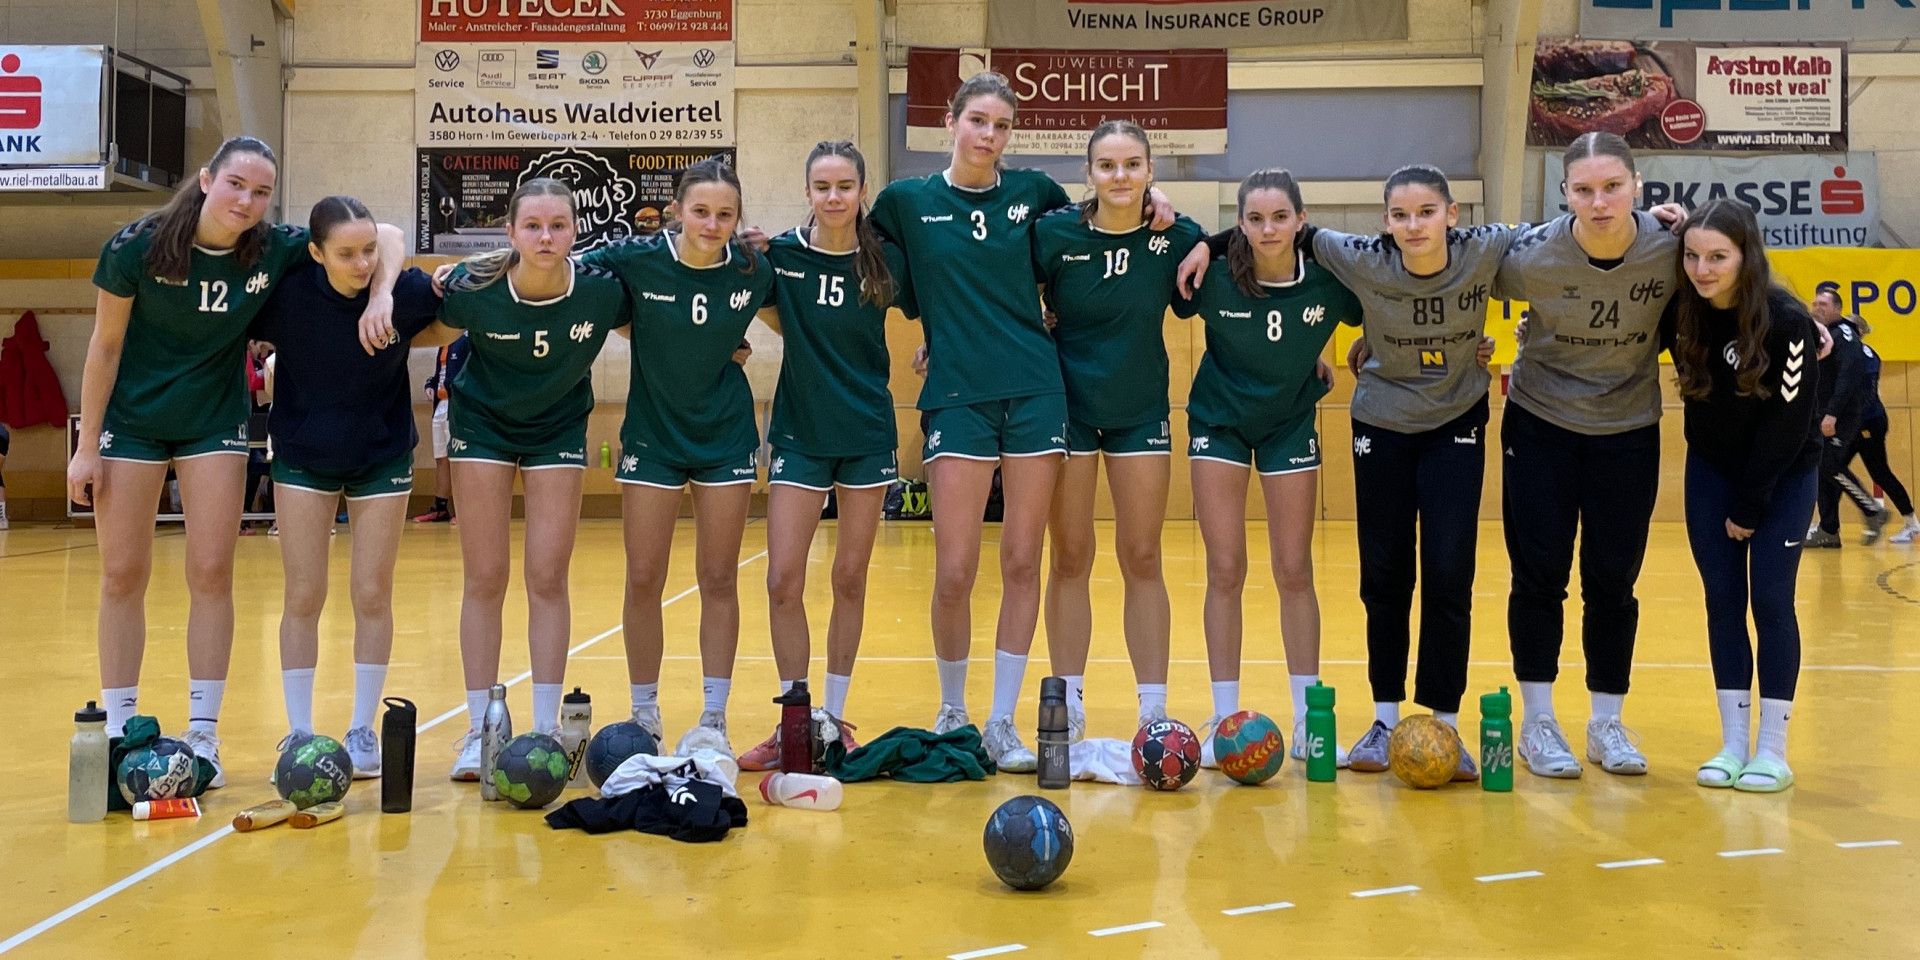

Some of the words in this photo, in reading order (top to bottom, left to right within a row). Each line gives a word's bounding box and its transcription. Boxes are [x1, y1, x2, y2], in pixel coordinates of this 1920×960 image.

[644, 9, 668, 19] 3730
[670, 8, 722, 21] Eggenburg
[1067, 9, 1138, 30] VIENNA
[1144, 10, 1251, 30] INSURANCE
[1257, 7, 1325, 27] GROUP
[428, 21, 457, 32] Maler
[465, 21, 523, 32] Anstreicher
[531, 21, 627, 34] Fassadengestaltung
[637, 21, 648, 31] T:
[650, 21, 688, 32] 0699/12
[690, 21, 708, 31] 928
[710, 21, 729, 32] 444
[1048, 56, 1135, 70] JUWELIER
[428, 79, 465, 88] Service
[480, 72, 503, 80] Audi
[527, 72, 567, 81] SEAT
[690, 79, 717, 88] Service
[1728, 78, 1783, 96] finest
[428, 101, 558, 125] Autohaus
[563, 99, 722, 124] Waldviertel
[1015, 113, 1087, 127] schmuck
[1121, 114, 1168, 127] hren
[428, 130, 456, 141] 3580
[458, 130, 483, 141] Horn
[491, 130, 505, 141] Im
[507, 130, 578, 143] Gewerbepark
[580, 130, 599, 141] 2-4
[608, 130, 647, 141] Telefon
[659, 130, 673, 141] 29
[675, 129, 707, 141] 82/39
[709, 129, 723, 140] 55
[1036, 132, 1074, 141] BARBARA
[442, 154, 520, 171] CATERING
[0, 173, 99, 187] w.riel-metallbau.at
[970, 209, 988, 242] 3
[1102, 247, 1130, 280] 10
[198, 279, 229, 313] 12
[815, 273, 845, 307] 15
[690, 292, 709, 326] 6
[1412, 296, 1446, 326] 89
[1588, 299, 1620, 330] 24
[1266, 309, 1283, 342] 8
[532, 329, 550, 359] 5
[1308, 438, 1316, 454] 8
[1044, 746, 1058, 759] air
[1053, 754, 1065, 769] up
[152, 755, 189, 799] SELECT
